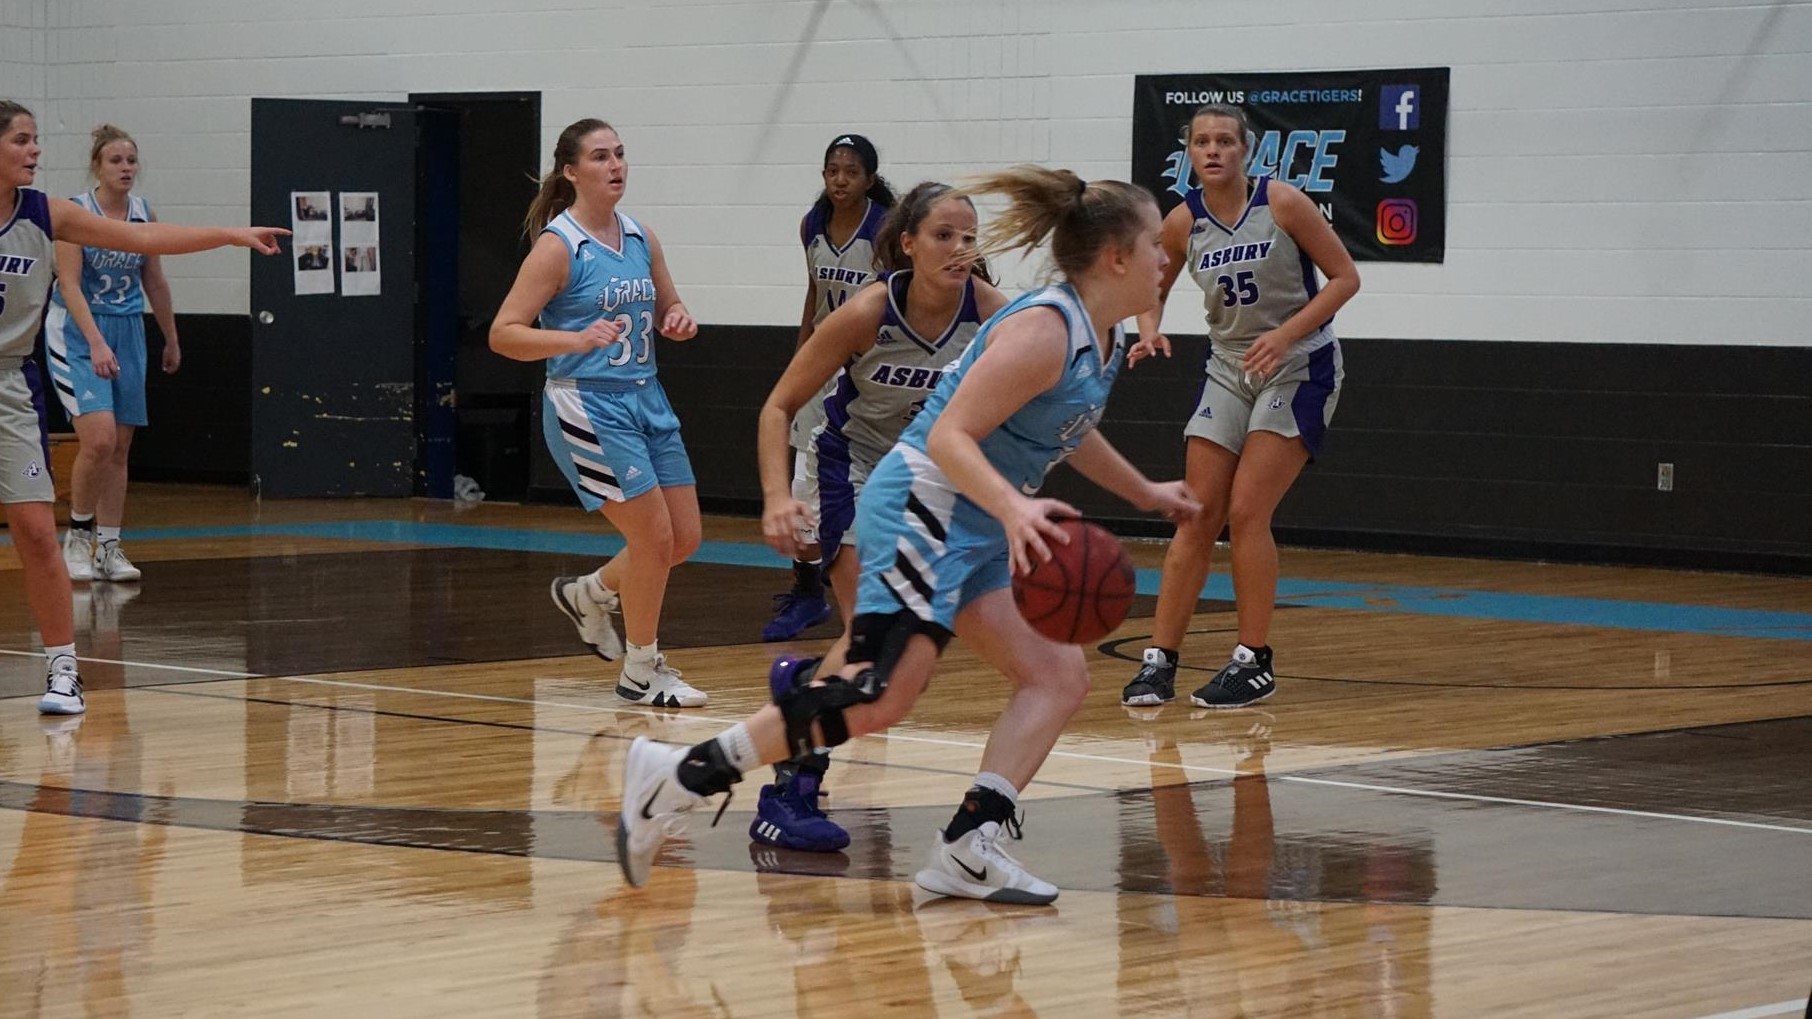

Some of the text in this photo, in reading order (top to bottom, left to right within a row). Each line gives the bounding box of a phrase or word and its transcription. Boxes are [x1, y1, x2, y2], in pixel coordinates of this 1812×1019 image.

[1165, 89, 1362, 105] FOLLOW US @GRACETIGERS!
[1197, 240, 1275, 272] ASBURY
[91, 274, 131, 304] 23
[1216, 270, 1260, 308] 35
[608, 310, 653, 366] 33
[868, 362, 944, 392] ASBU
